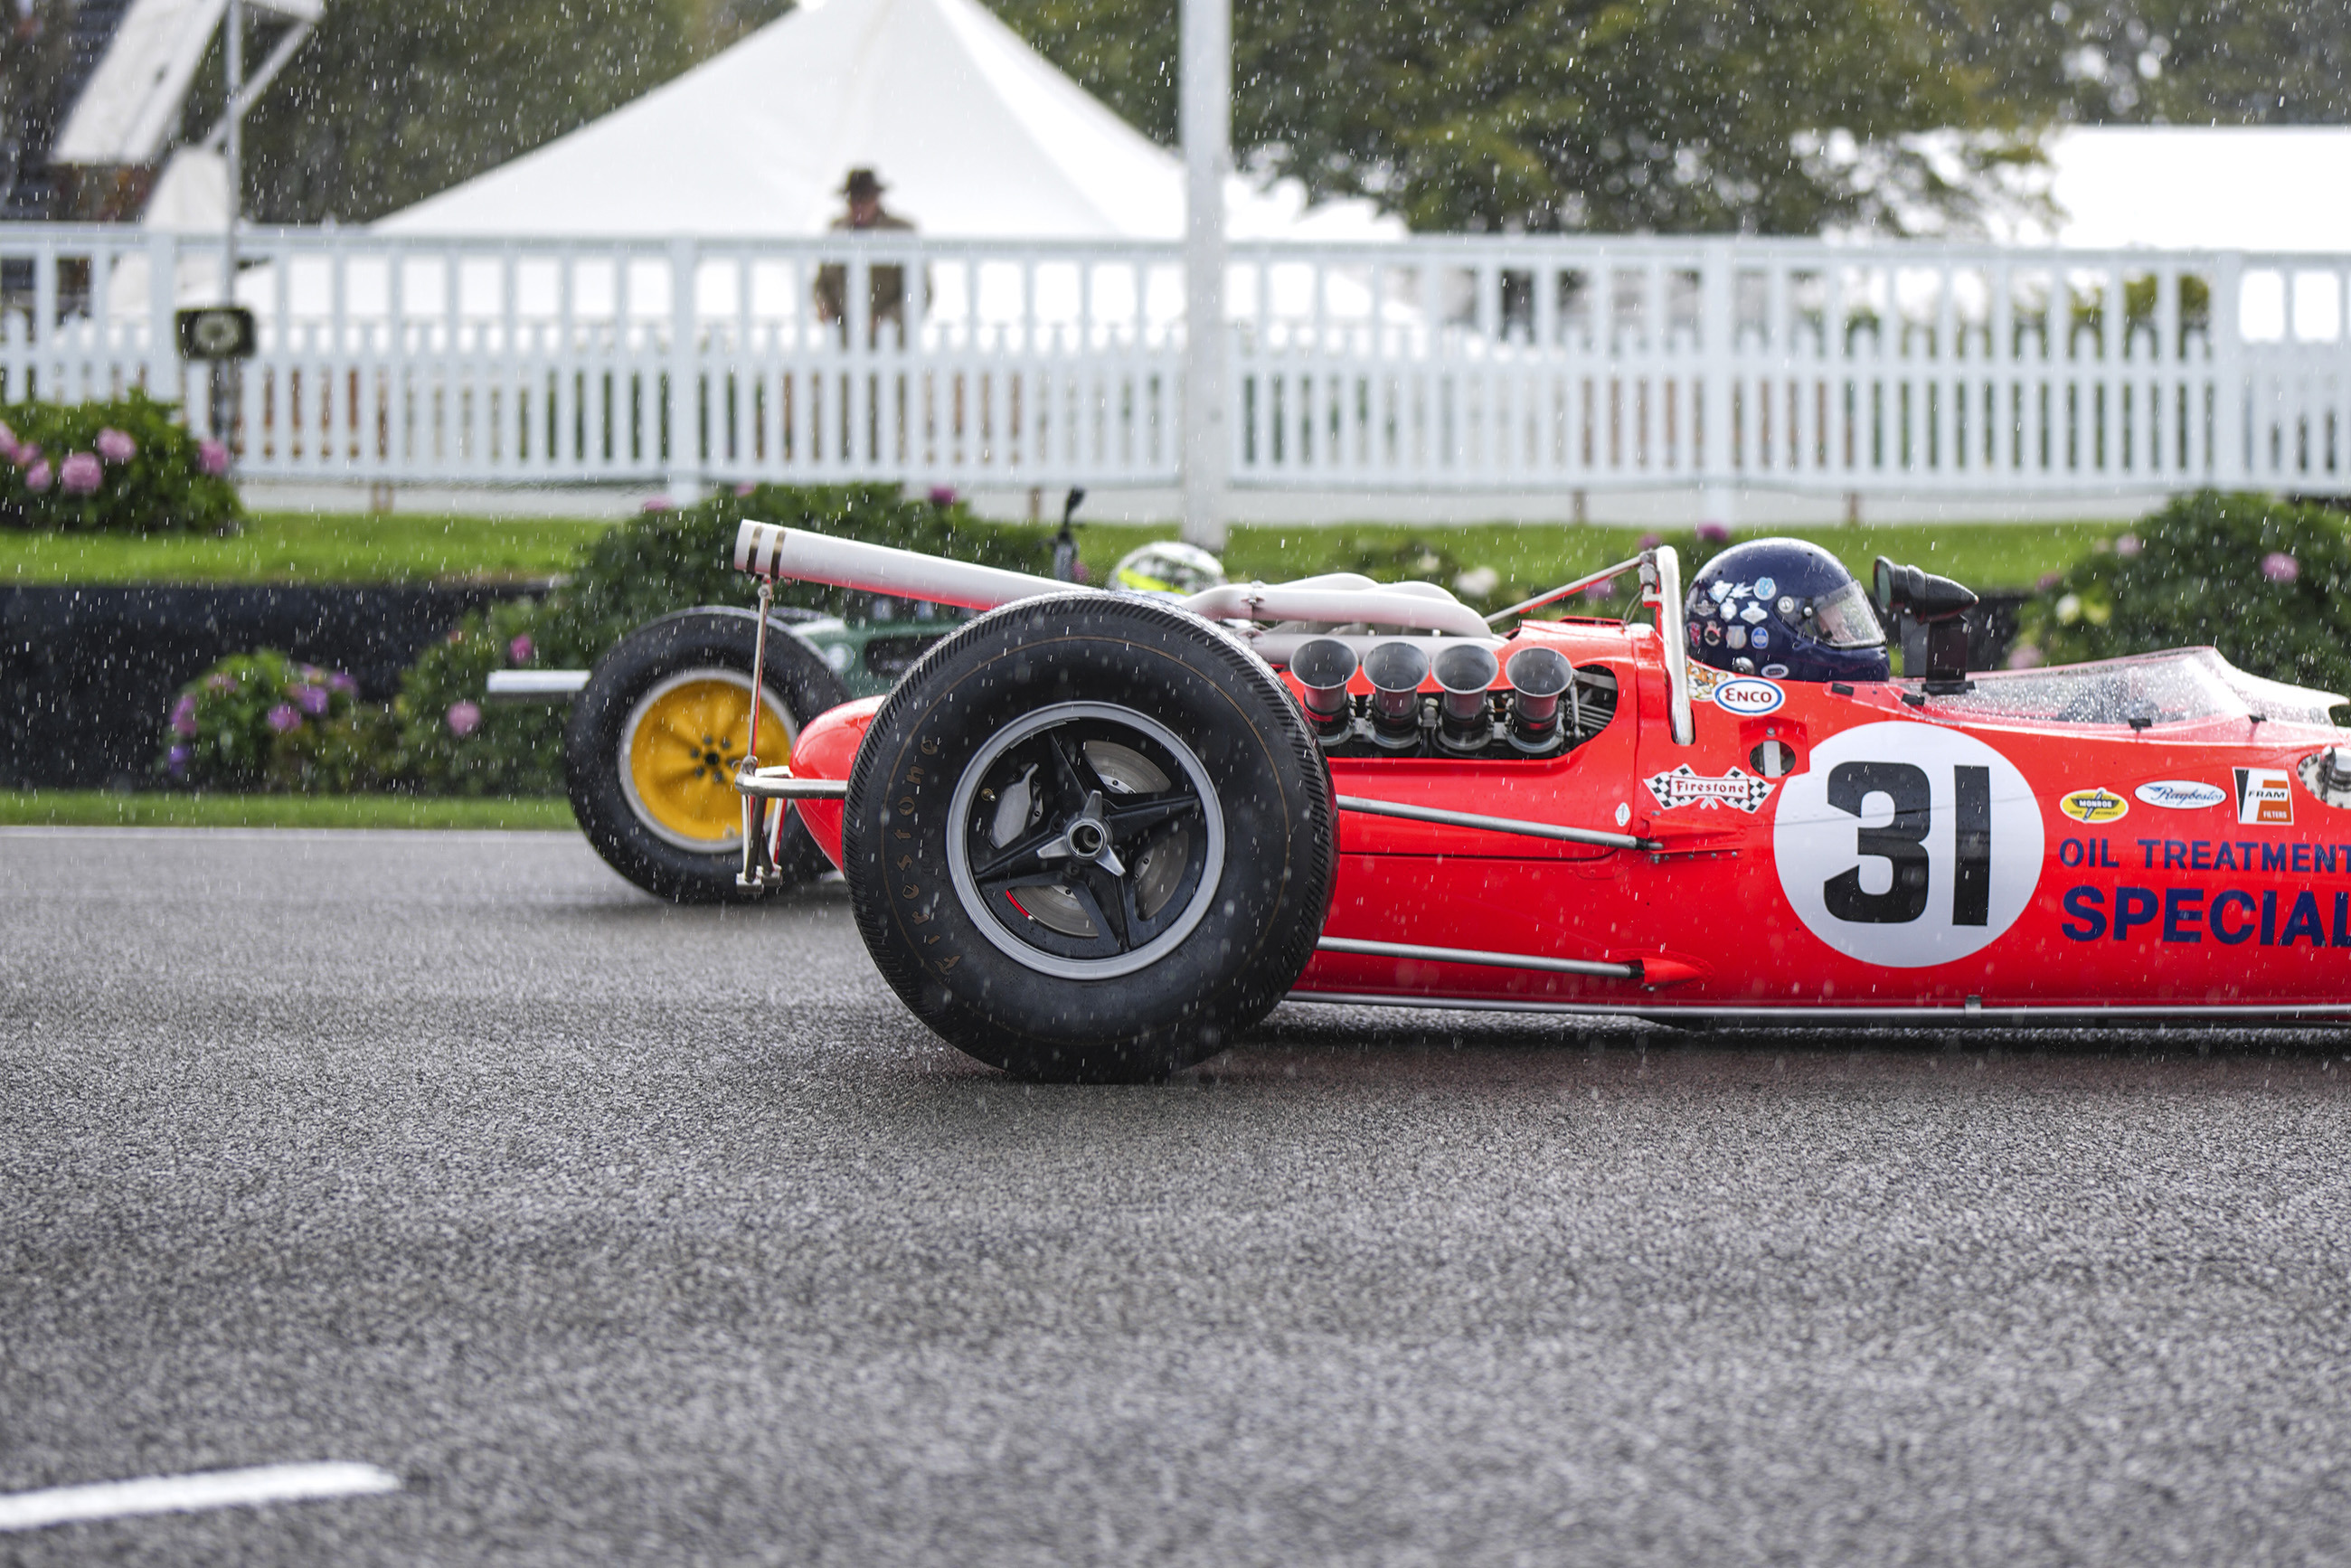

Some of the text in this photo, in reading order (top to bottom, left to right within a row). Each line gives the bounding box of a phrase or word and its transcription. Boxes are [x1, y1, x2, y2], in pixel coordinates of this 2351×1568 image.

[1724, 687, 1772, 703] ENCO
[1675, 779, 1745, 794] Firestone
[2144, 785, 2224, 807] Raybestos
[2248, 789, 2285, 798] FRAM
[2262, 809, 2288, 819] FILTERS
[1823, 760, 1991, 927] 31
[893, 739, 961, 977] Firestone
[2059, 837, 2351, 874] OIL TREATMENT
[2061, 884, 2351, 948] SPECIAL
